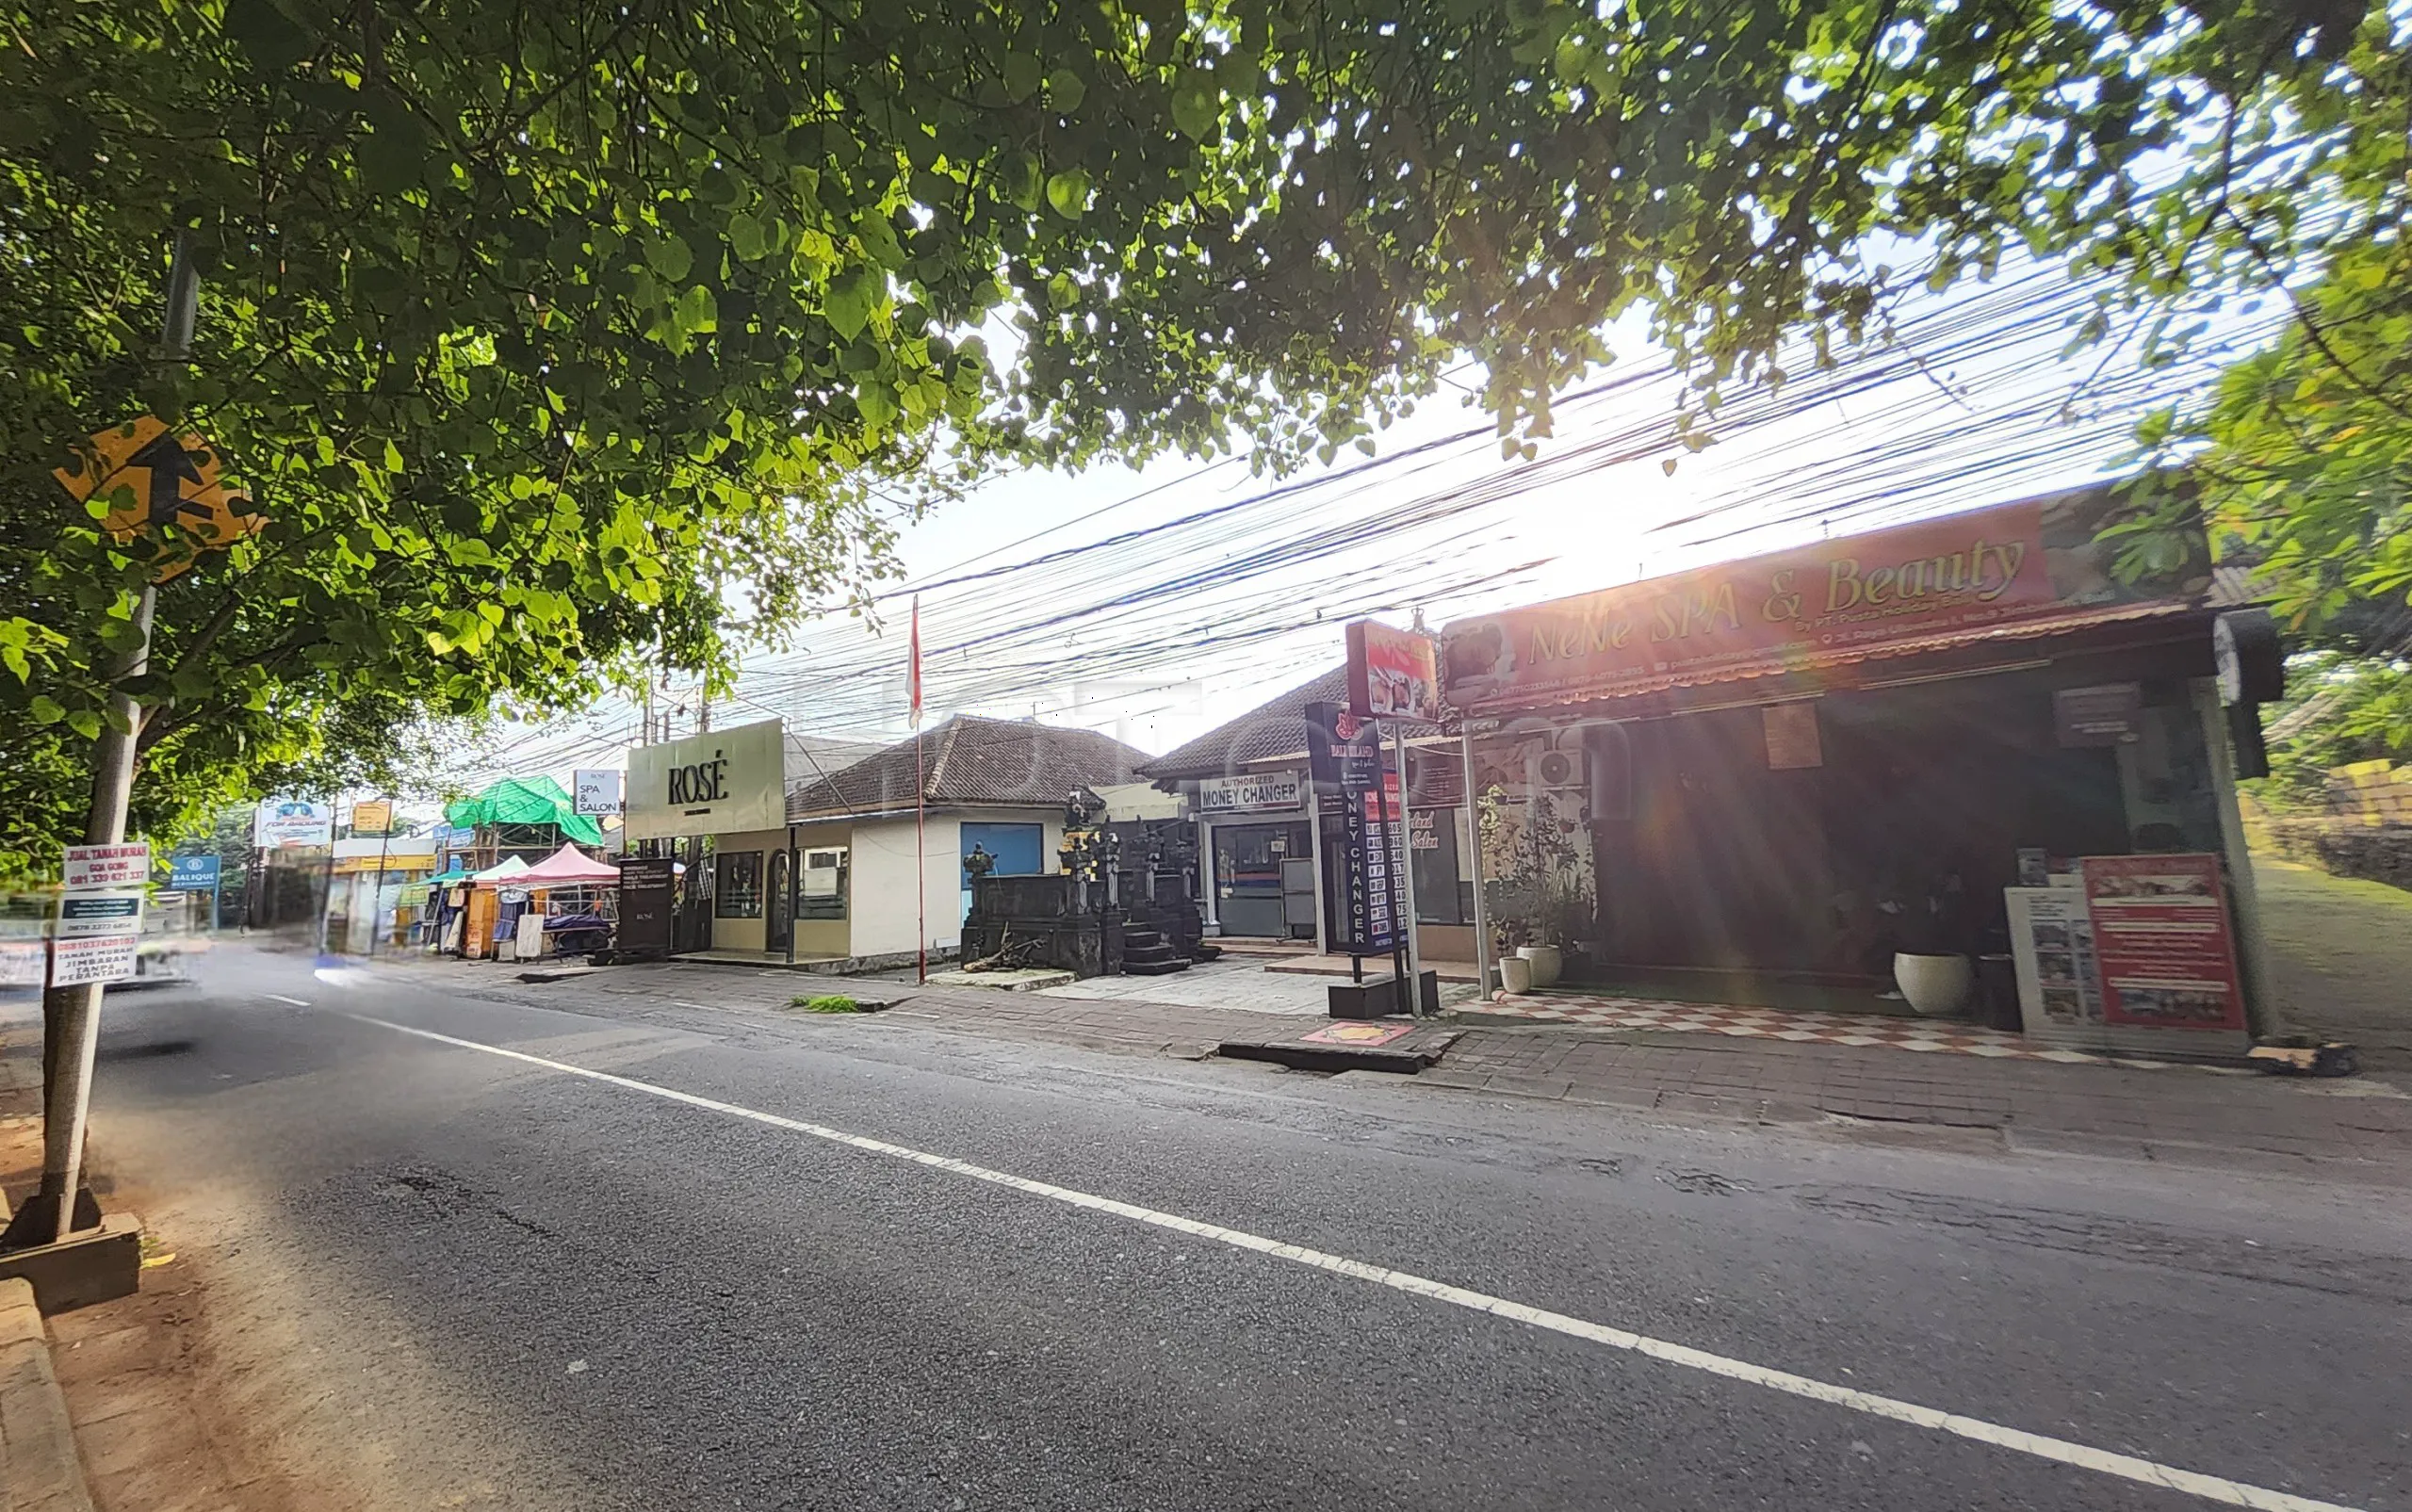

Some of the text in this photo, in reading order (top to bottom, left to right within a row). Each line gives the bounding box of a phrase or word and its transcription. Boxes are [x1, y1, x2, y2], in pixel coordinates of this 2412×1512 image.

[1651, 582, 1742, 643] SPA
[1761, 569, 1801, 623] &
[1821, 539, 2025, 613] Beauty
[668, 749, 730, 805] ROSÉ
[1221, 775, 1275, 788] AUTHORIZED
[579, 785, 600, 793] SPA
[1202, 784, 1297, 806] MONEY CHANGER
[579, 803, 617, 811] SALON
[1411, 830, 1439, 849] Salon
[172, 872, 215, 881] BALIQUE
[1350, 847, 1365, 943] CHANGER
[64, 955, 128, 968] JIMBARAN
[58, 967, 129, 982] PERANTARA
[76, 964, 115, 974] TANPA
